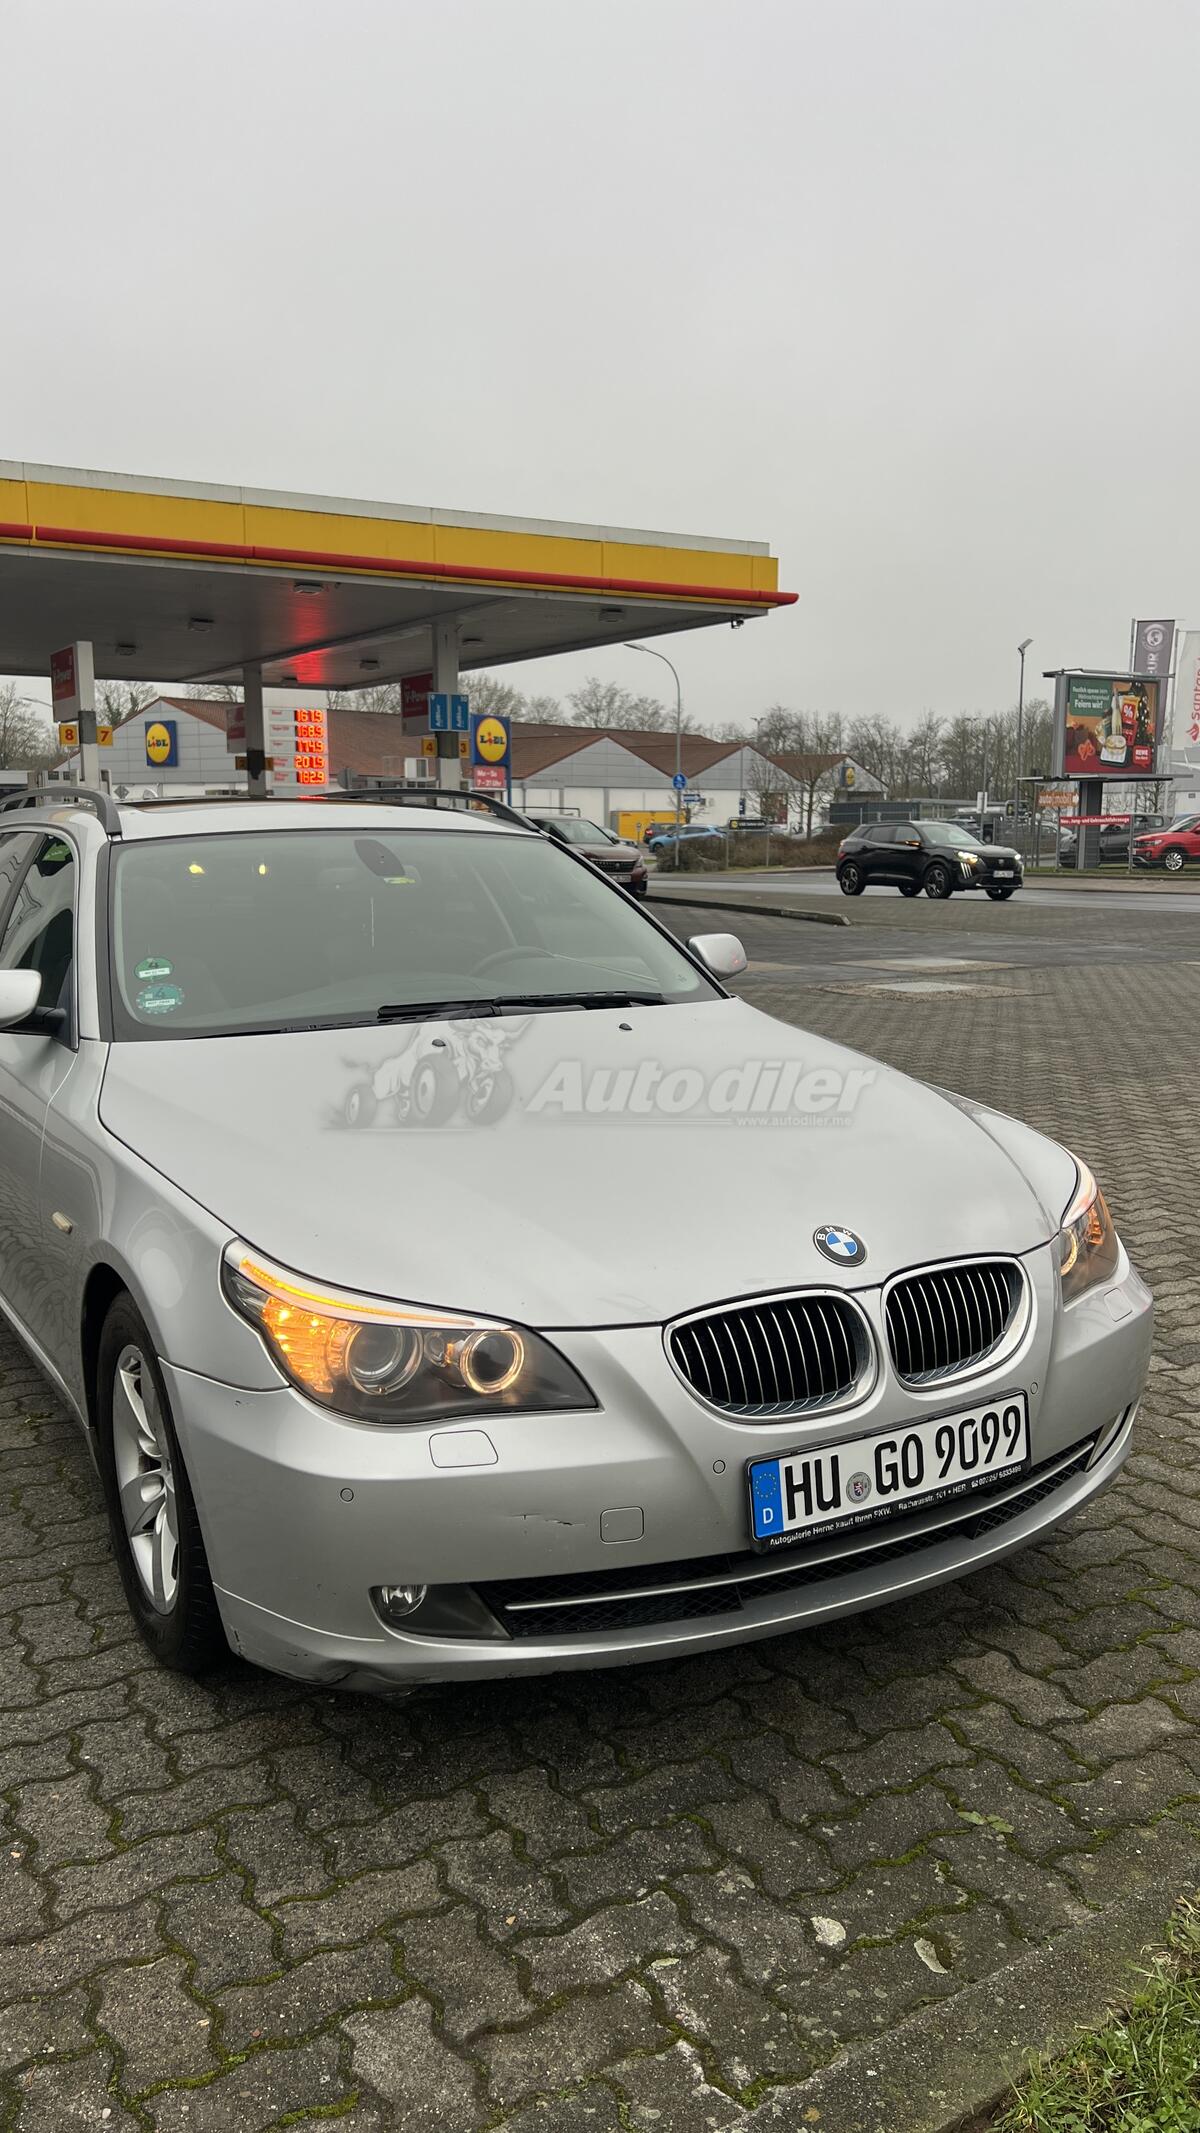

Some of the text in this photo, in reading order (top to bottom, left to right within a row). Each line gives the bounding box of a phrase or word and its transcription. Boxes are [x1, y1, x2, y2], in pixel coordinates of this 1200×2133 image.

[65, 729, 74, 742] 8
[100, 730, 110, 742] 7
[426, 742, 433, 752] 4
[460, 743, 467, 753] 3
[784, 1454, 842, 1521] HU
[935, 1404, 1021, 1479] 9099
[763, 1507, 774, 1524] D
